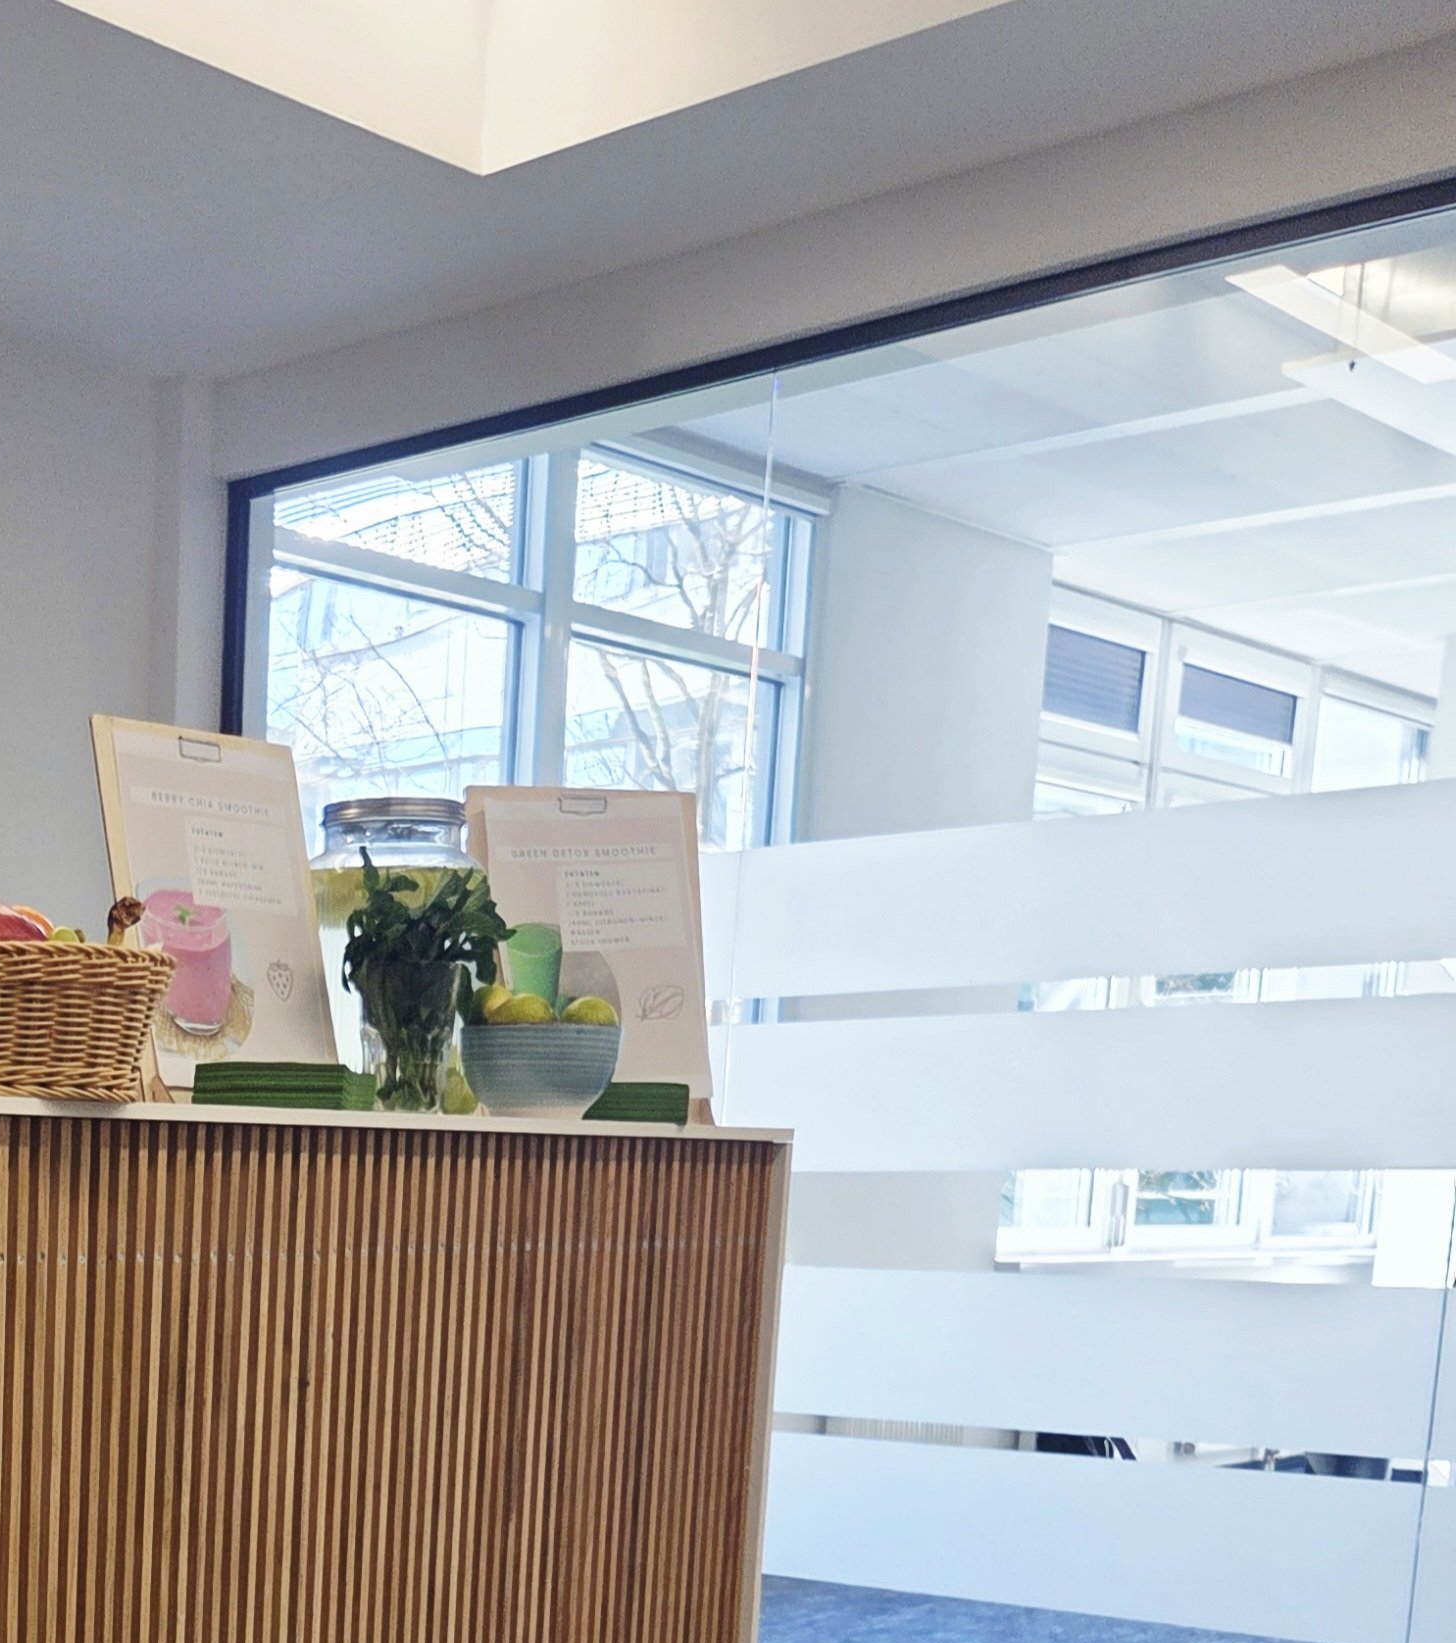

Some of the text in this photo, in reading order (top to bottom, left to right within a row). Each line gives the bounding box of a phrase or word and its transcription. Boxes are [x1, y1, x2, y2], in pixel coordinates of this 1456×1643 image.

[151, 791, 269, 817] BERRY CHIA SMOOTHIE
[511, 845, 657, 859] GREEN DETOX SMOOTHIE
